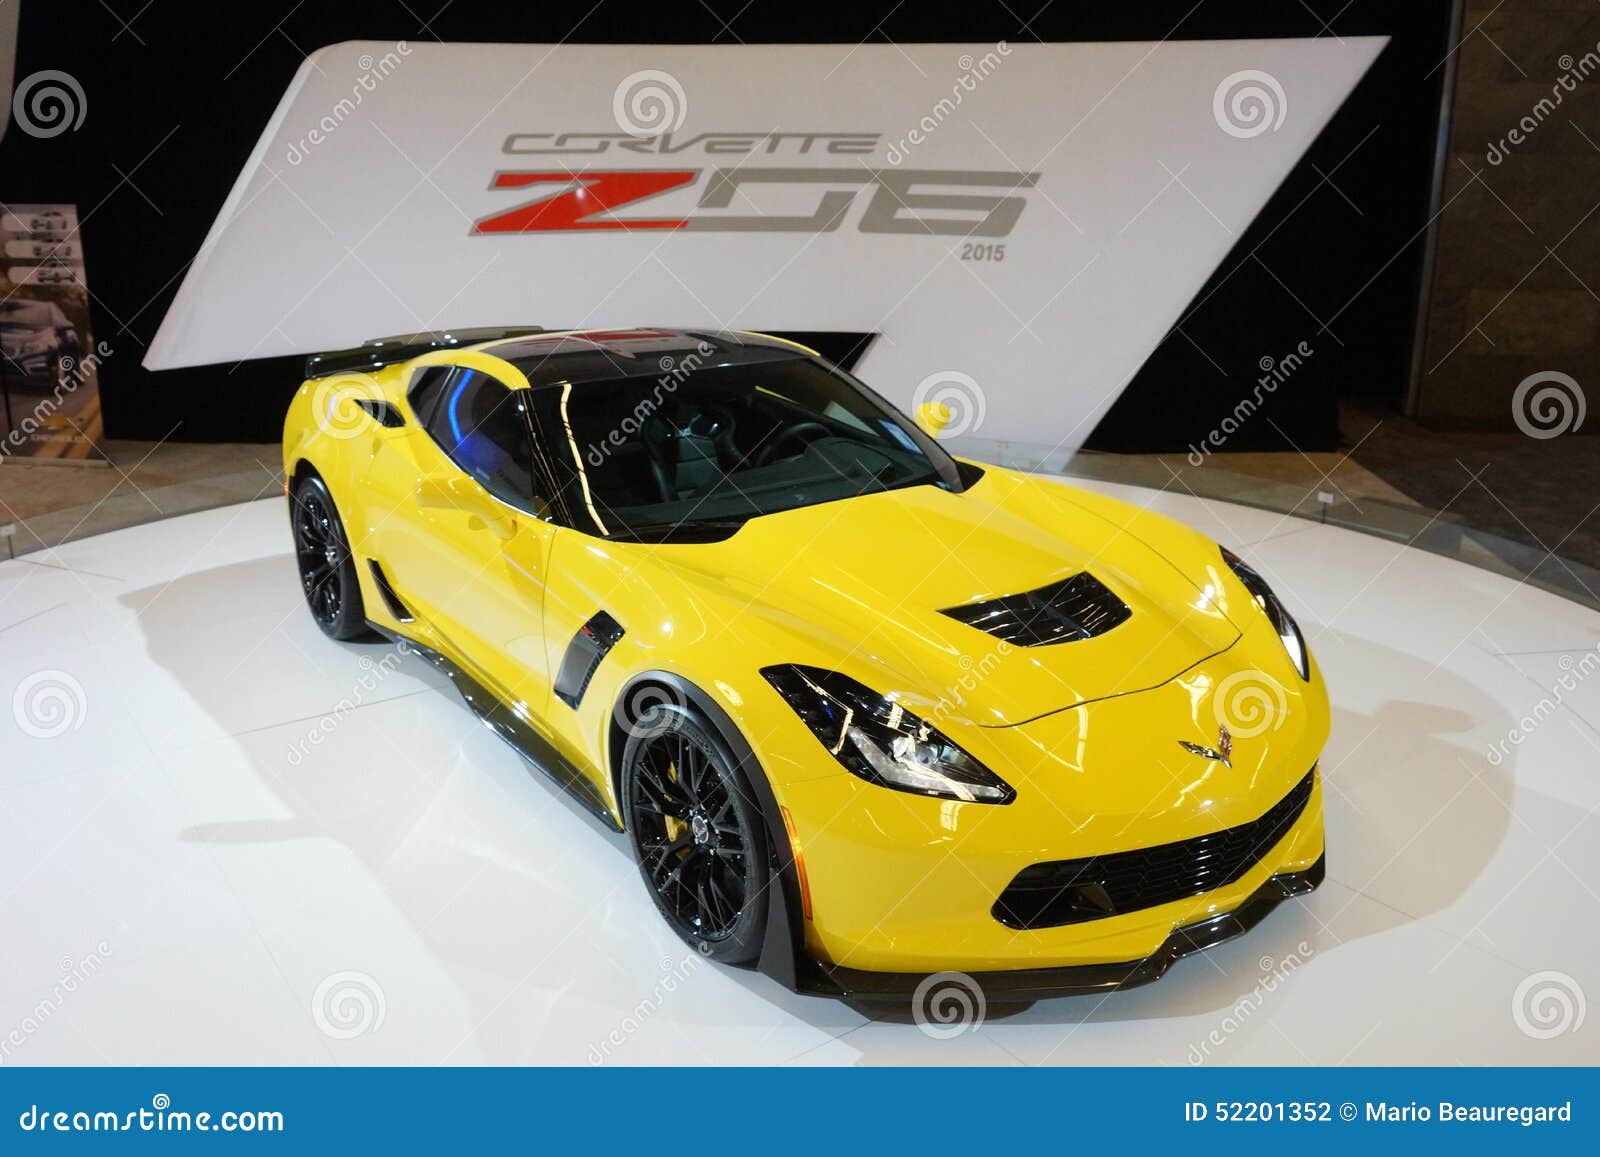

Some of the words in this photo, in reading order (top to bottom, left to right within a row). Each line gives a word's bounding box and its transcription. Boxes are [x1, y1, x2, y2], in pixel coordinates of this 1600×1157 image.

[501, 133, 883, 155] CORVETTE
[469, 168, 1041, 237] Z06
[961, 243, 1006, 262] 2015
